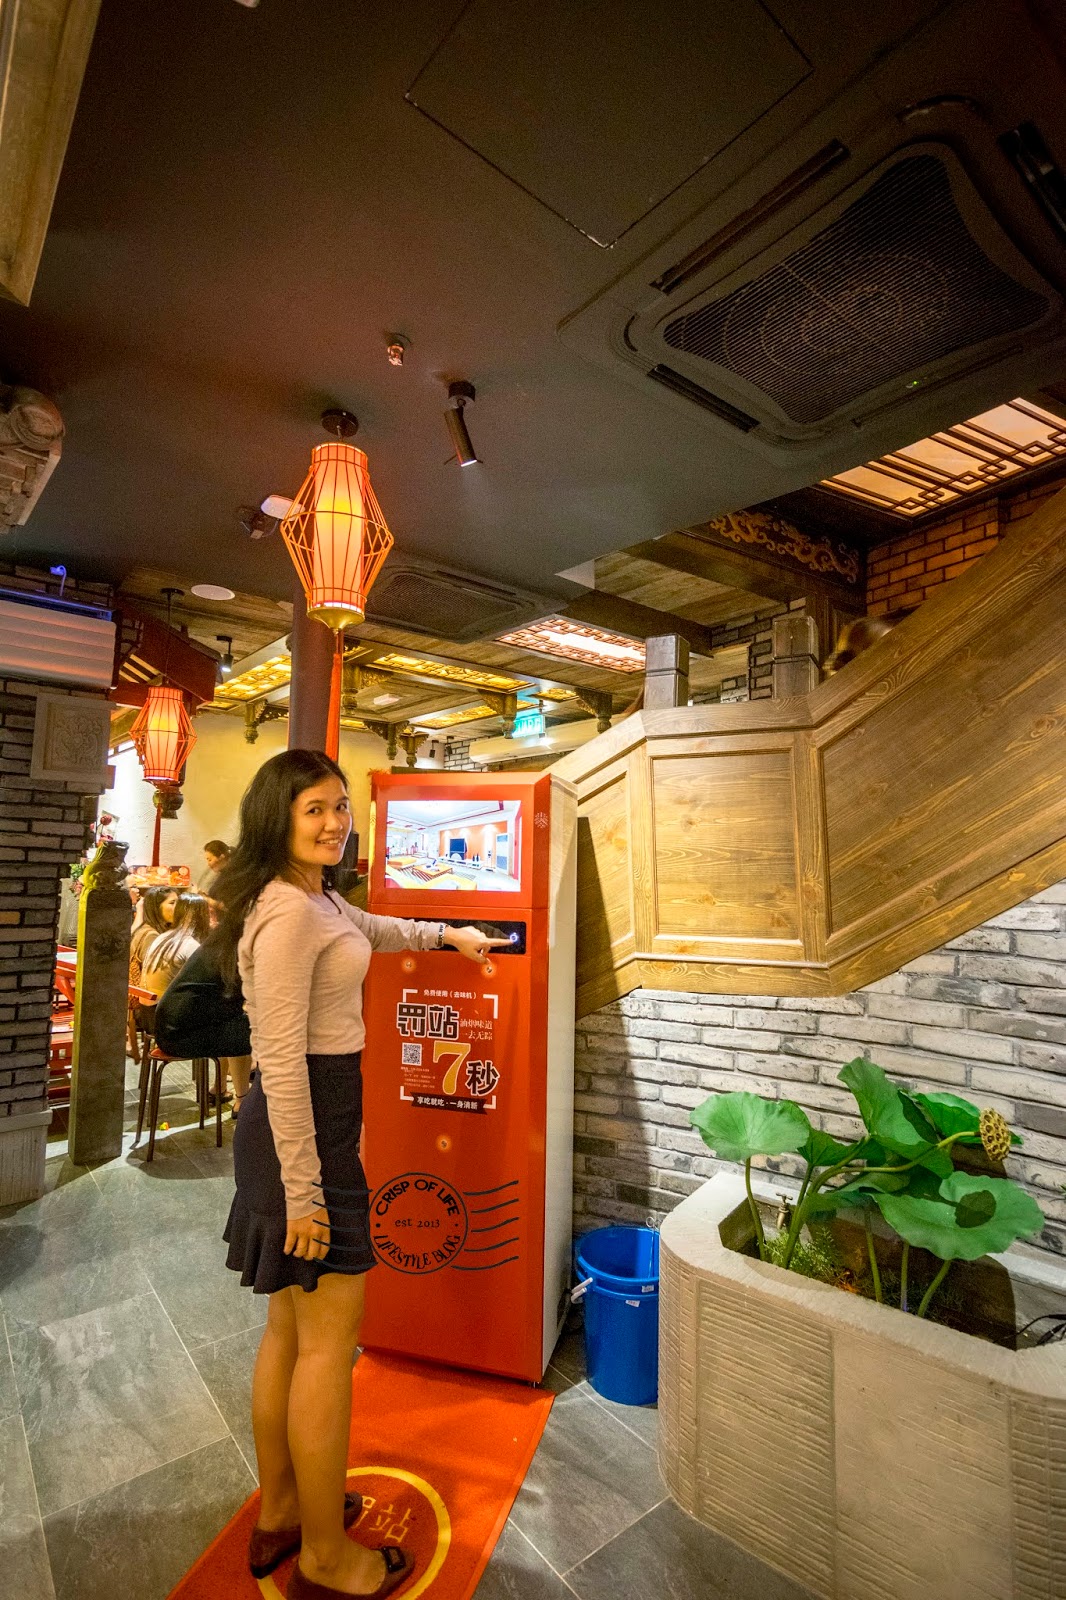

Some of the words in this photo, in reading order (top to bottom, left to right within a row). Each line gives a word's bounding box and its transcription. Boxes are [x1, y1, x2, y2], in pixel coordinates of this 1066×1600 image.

[397, 1002, 459, 1040] 罚站
[375, 1180, 410, 1216] CRISP
[414, 1179, 438, 1192] OF
[437, 1187, 460, 1217] LIFE
[394, 1218, 412, 1228] est
[417, 1219, 440, 1228] 2013
[373, 1234, 432, 1270] LIFESTYLE
[432, 1235, 461, 1263] BLOG
